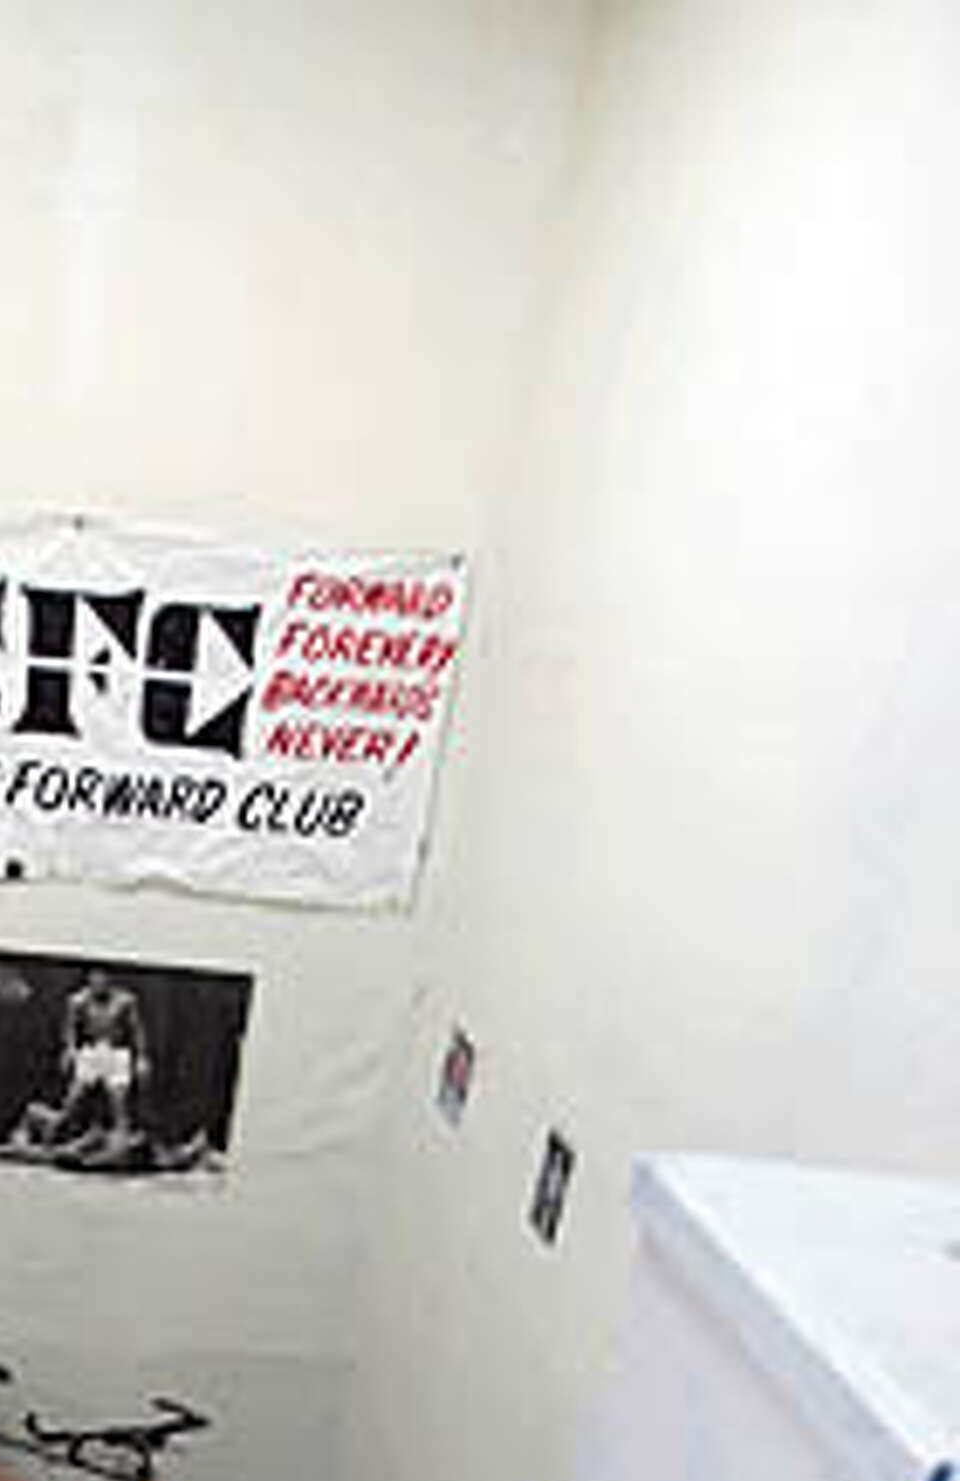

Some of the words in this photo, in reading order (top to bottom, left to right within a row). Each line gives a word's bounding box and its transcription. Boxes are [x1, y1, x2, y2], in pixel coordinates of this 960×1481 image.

[287, 572, 453, 619] FORWARD
[265, 722, 421, 765] NEVER!
[5, 762, 228, 824] FORWARD
[236, 782, 366, 837] CLUB
